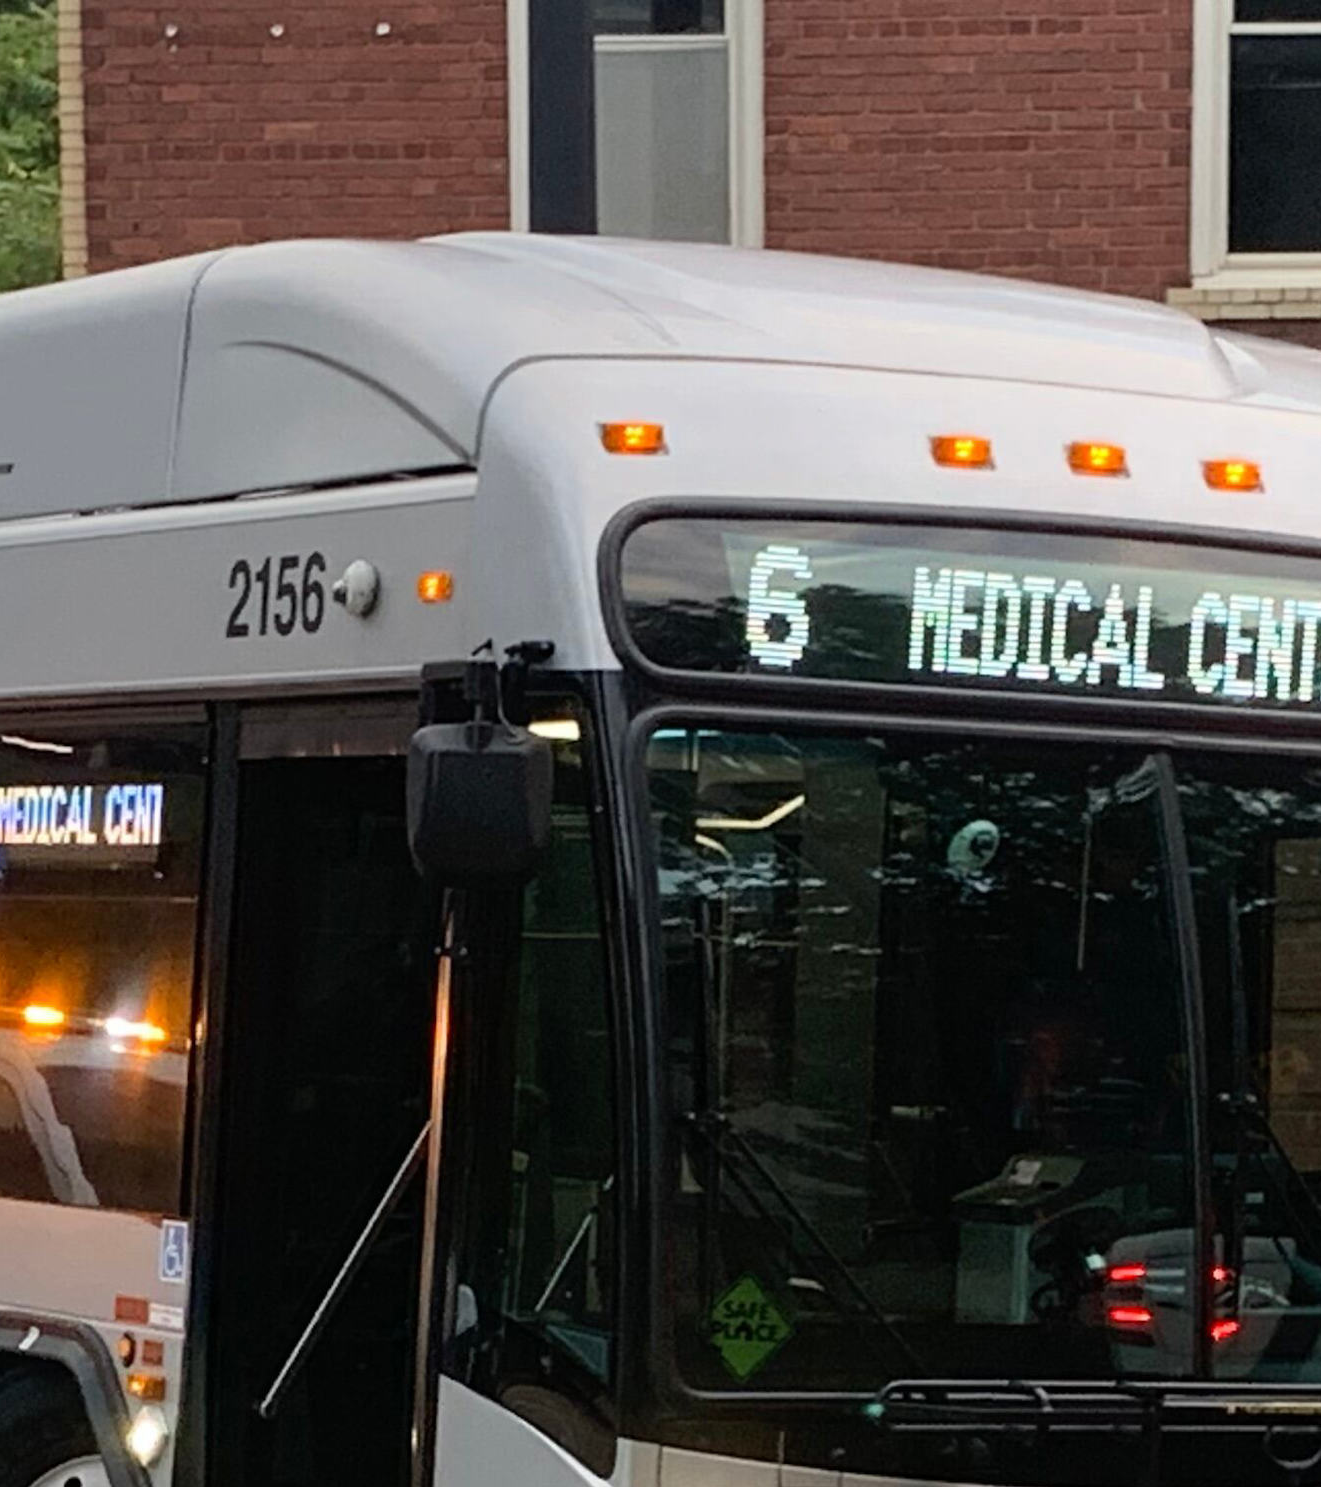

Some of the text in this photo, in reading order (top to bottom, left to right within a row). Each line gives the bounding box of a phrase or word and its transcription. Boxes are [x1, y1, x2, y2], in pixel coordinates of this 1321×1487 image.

[226, 551, 326, 638] 2156
[746, 545, 813, 668] 6
[907, 566, 1164, 690] MEDICAL
